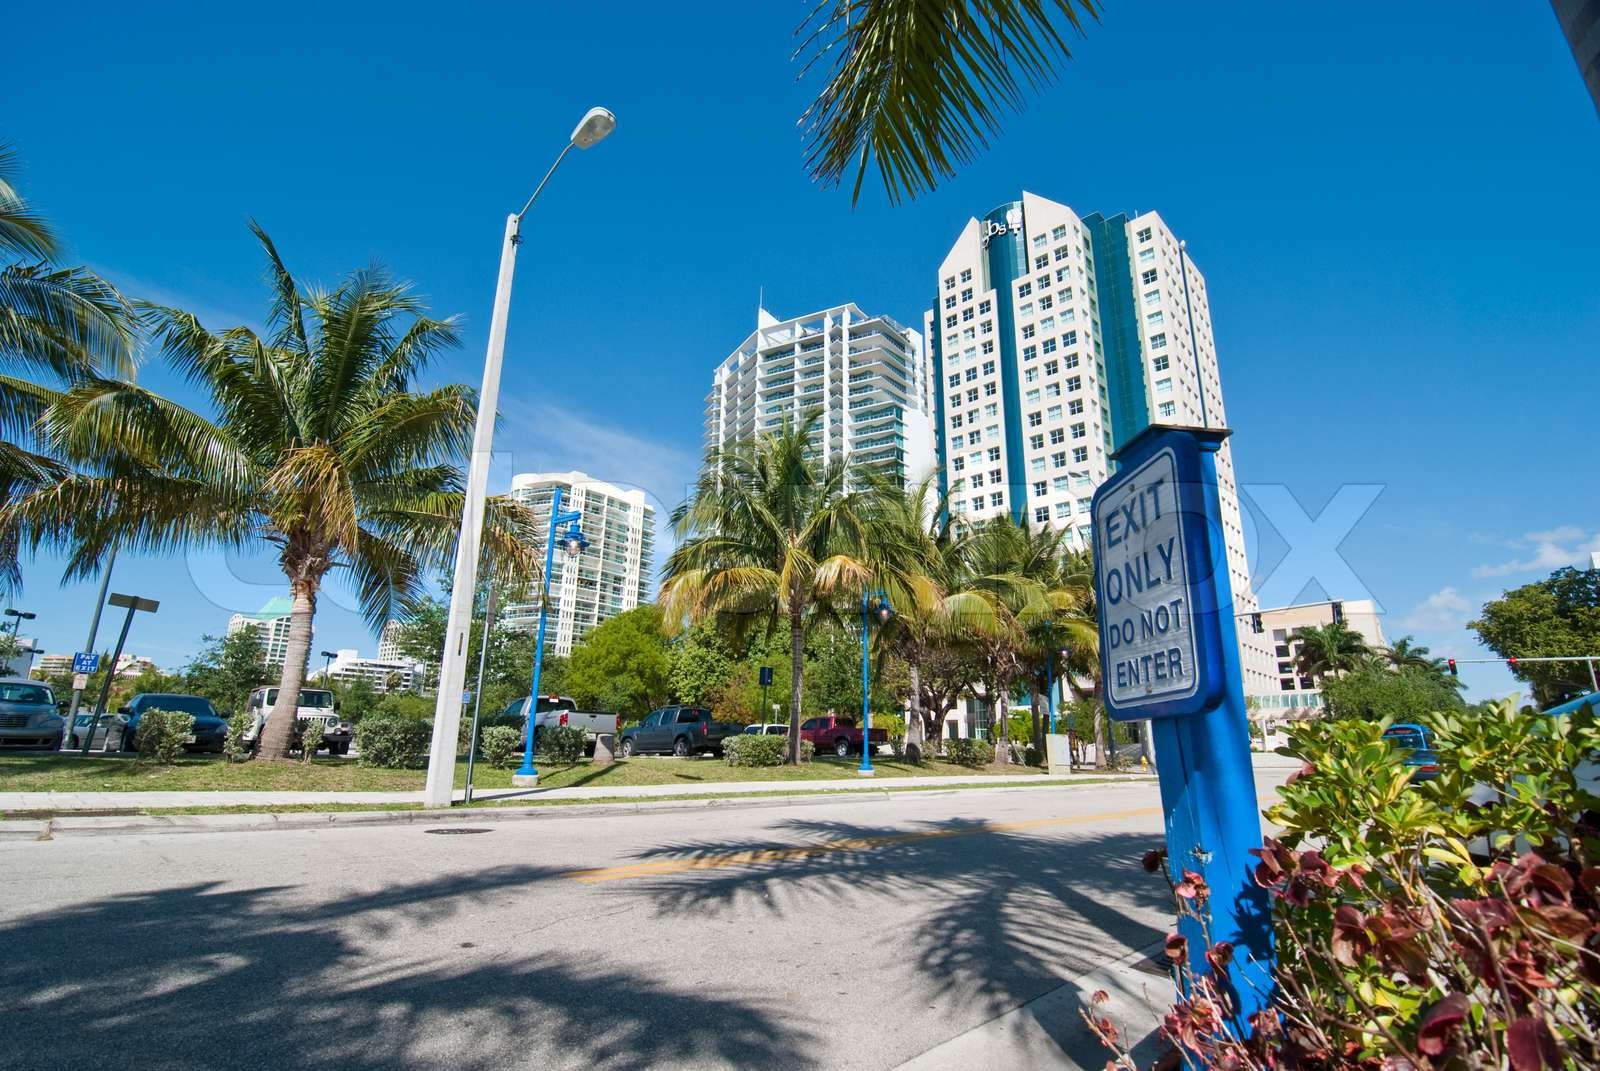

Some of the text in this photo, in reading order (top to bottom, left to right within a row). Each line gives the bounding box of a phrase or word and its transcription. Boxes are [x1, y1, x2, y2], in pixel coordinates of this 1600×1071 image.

[1105, 479, 1164, 549] EXIT
[1105, 536, 1175, 606] ONLY
[1109, 598, 1183, 649] DO NOT
[1116, 647, 1185, 688] ENTER
